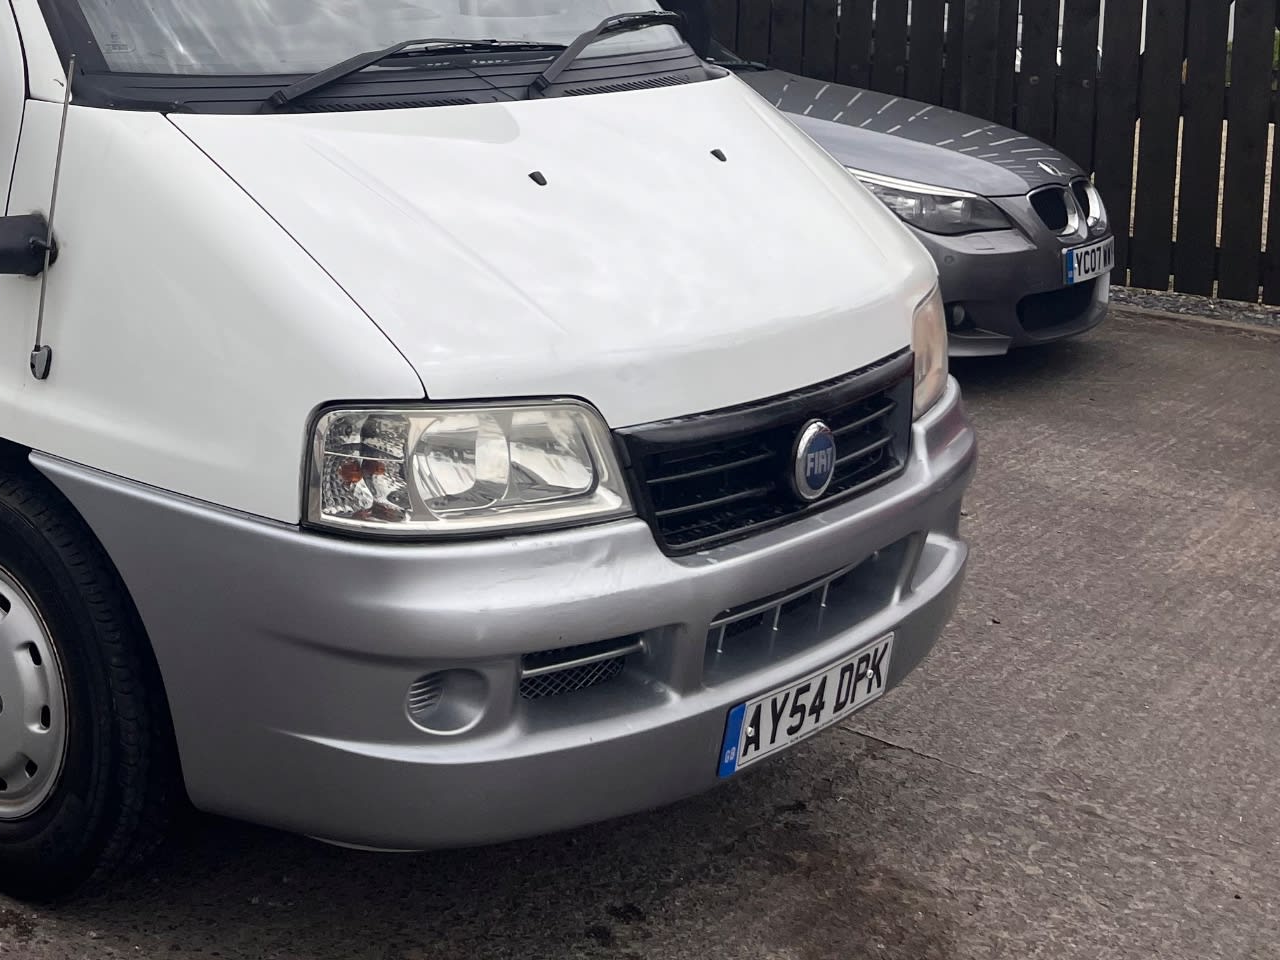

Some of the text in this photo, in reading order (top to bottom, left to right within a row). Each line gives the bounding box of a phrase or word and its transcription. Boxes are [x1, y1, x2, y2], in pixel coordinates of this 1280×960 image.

[1075, 246, 1102, 277] YC07
[806, 446, 833, 477] FIAT
[741, 641, 890, 758] AY54 DPK
